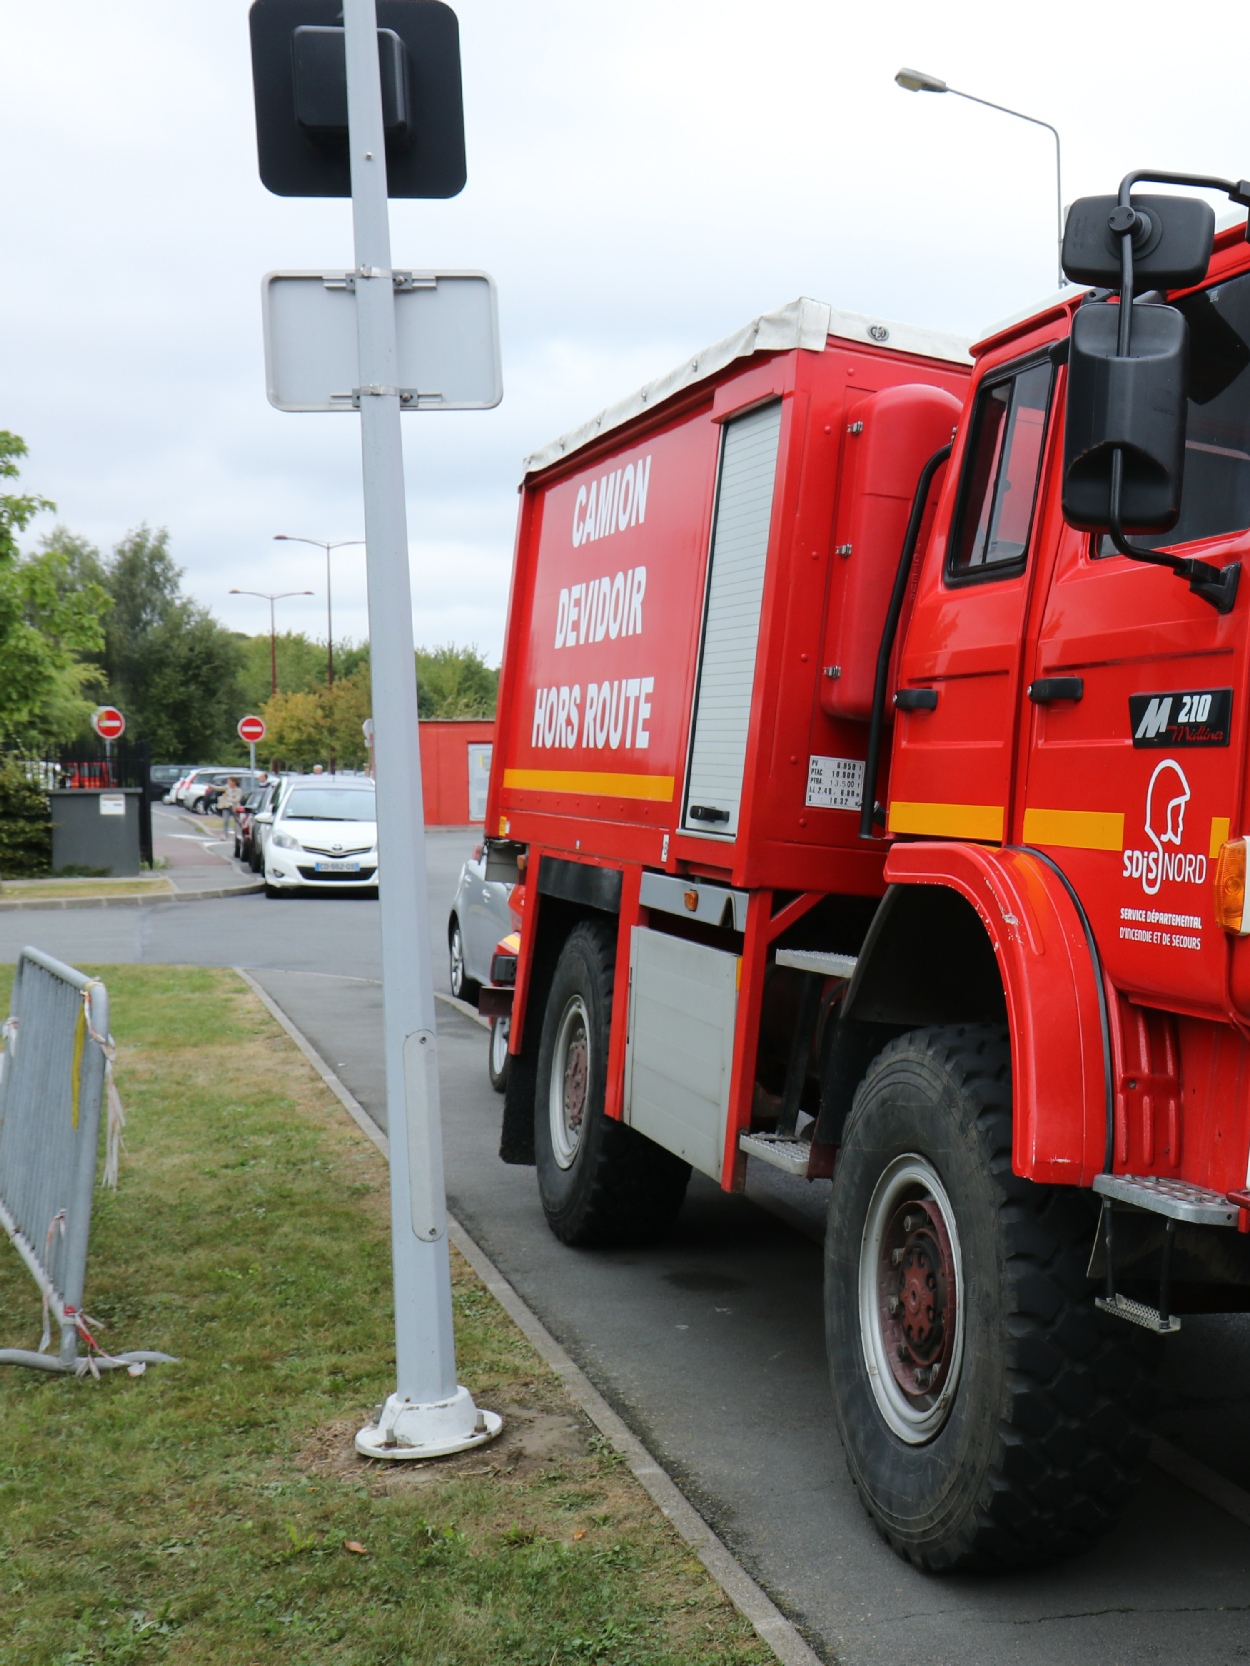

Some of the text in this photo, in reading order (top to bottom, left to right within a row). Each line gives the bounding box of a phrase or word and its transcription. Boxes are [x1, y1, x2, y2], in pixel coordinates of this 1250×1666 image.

[572, 455, 651, 547] CAMION
[554, 566, 646, 649] DEVIDOIR
[531, 677, 654, 749] HORS ROUTE
[1134, 694, 1212, 739] M 210
[1167, 726, 1224, 742] Midliner
[1163, 853, 1207, 884] NORD
[1120, 908, 1203, 929] SERVICE DÉPARTEMENTAL
[1119, 927, 1202, 950] D'INCENDIE ET DE SECOURS
